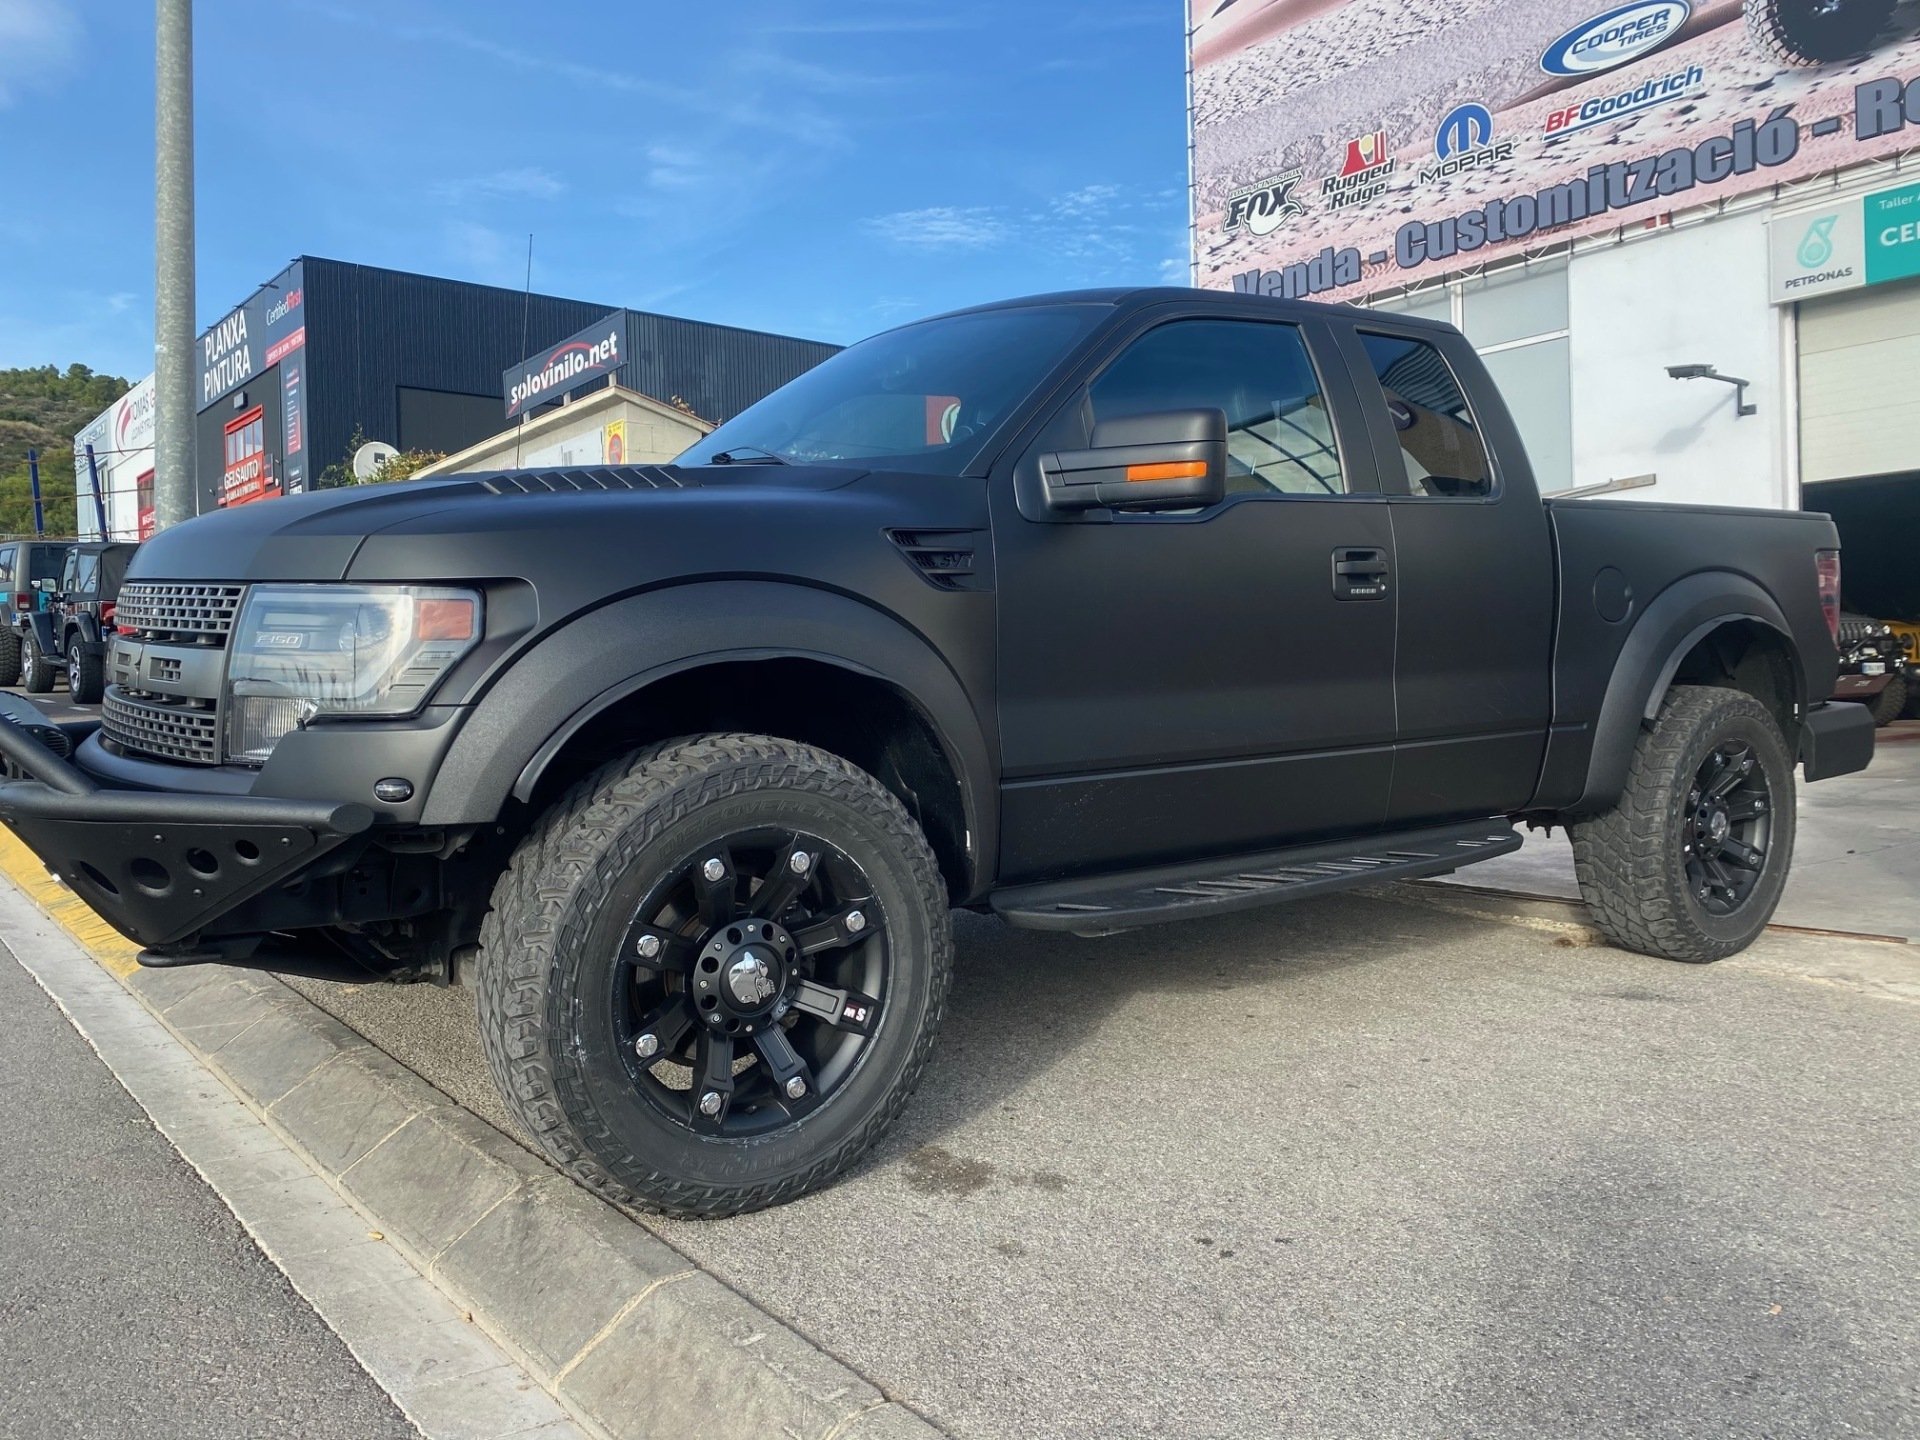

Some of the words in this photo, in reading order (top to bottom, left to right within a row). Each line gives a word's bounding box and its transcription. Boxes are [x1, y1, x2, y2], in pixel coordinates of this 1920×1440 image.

[1572, 8, 1671, 55] COOPER
[1618, 21, 1669, 48] TIRES
[1545, 65, 1704, 134] BFGoodrich
[1321, 156, 1396, 197] Rugged
[1420, 142, 1513, 185] MOPAR
[1224, 180, 1300, 229] FOX
[1232, 247, 1362, 299] Venda
[1395, 102, 1800, 270] Customització
[1330, 182, 1387, 211] Ridge
[1878, 195, 1914, 210] Taller
[1880, 221, 1920, 247] CE
[1785, 266, 1853, 289] PETRONAS
[205, 309, 248, 367] PLANXA
[204, 344, 252, 403] PINTURA
[510, 331, 618, 405] solovinilo.net
[224, 459, 259, 490] GELSAUTO
